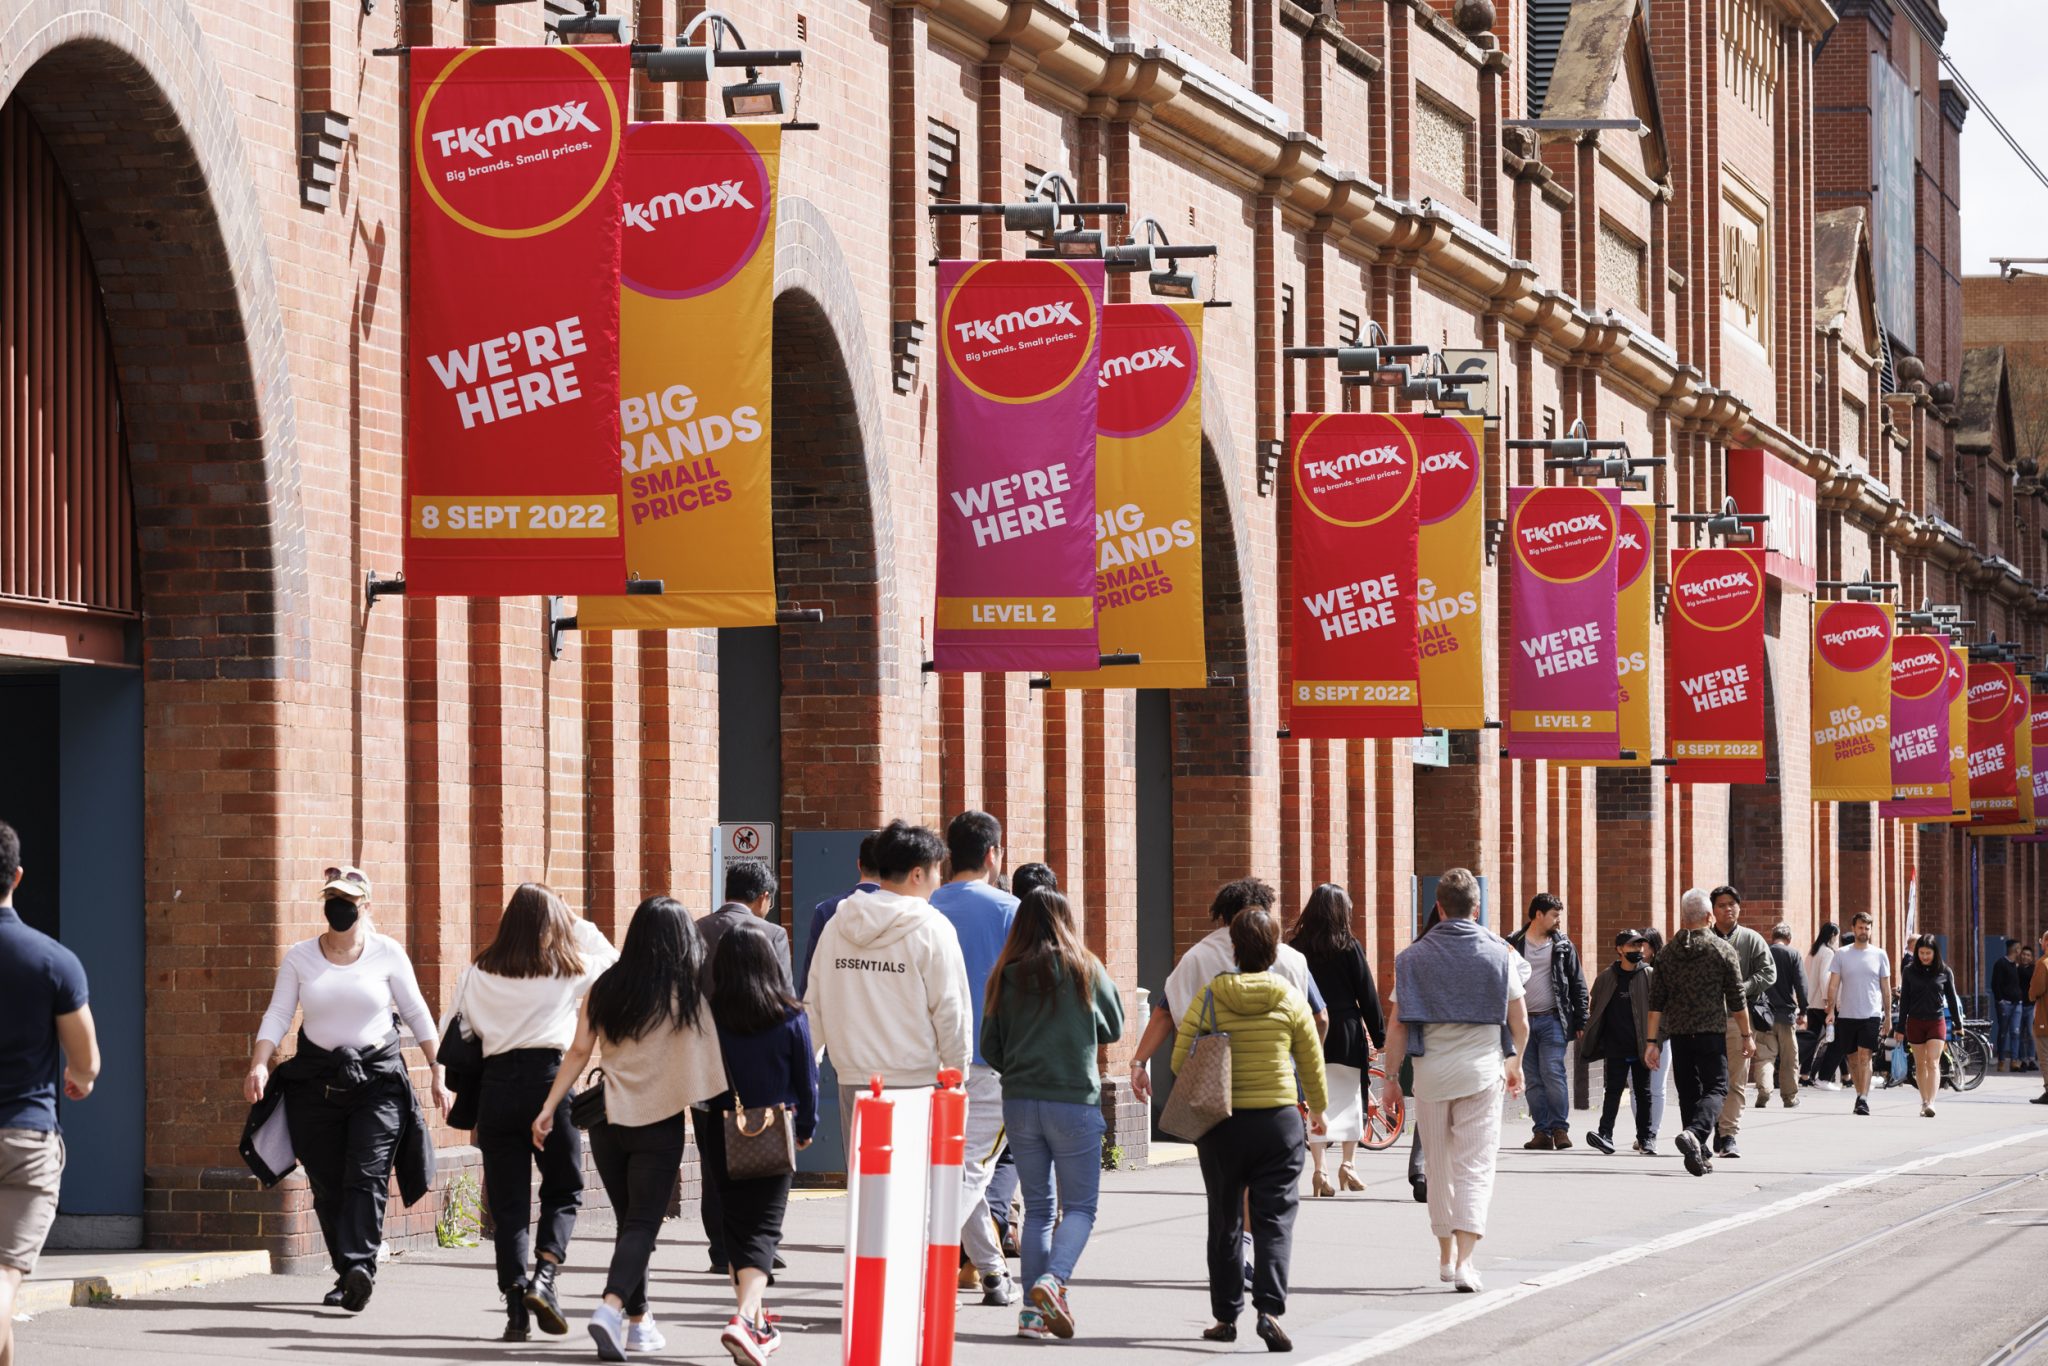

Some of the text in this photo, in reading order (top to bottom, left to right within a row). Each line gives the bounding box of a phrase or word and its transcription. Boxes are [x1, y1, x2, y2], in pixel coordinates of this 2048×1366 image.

[446, 141, 593, 182] Big brands. Small prices.
[427, 316, 588, 390] WE'RE
[965, 332, 1077, 362] Big brands. Small prices.
[456, 362, 583, 430] HERE
[620, 384, 698, 435] BIG
[620, 406, 763, 475] RANDS
[630, 457, 721, 499] SMALL
[951, 463, 1071, 518] WE'RE
[1313, 470, 1402, 494] Big brands. Small prices.
[421, 504, 606, 529] 8 SEPT 2022
[631, 480, 733, 526] PRICES
[971, 497, 1067, 547] HERE
[1096, 519, 1195, 571] ANDS
[1096, 560, 1164, 591] SMALL
[1096, 577, 1174, 613] PRICES
[1303, 573, 1400, 618] WE'RE
[972, 604, 1057, 622] LEVEL 2
[1320, 601, 1396, 641] HERE
[1418, 637, 1459, 659] ICES
[1520, 622, 1601, 658] WE'RE
[1535, 645, 1599, 678] HERE
[1298, 686, 1410, 701] 8 SEPT 2022
[1680, 664, 1750, 697] WE'RE
[1692, 684, 1748, 713] HERE
[1534, 715, 1592, 728] LEVEL 2
[1814, 714, 1888, 745] BRANDS
[1829, 705, 1862, 726] BIG
[1677, 744, 1758, 755] 8 SEPT 2022
[1834, 734, 1871, 751] SMALL
[1834, 743, 1876, 761] PRICES
[1890, 724, 1938, 750] WE'RE
[1894, 739, 1937, 763] HERE
[1968, 757, 2005, 779] HERE
[1895, 786, 1933, 797] LEVEL 2
[1970, 800, 1987, 809] EPT
[835, 958, 906, 974] ESSENTIALS
